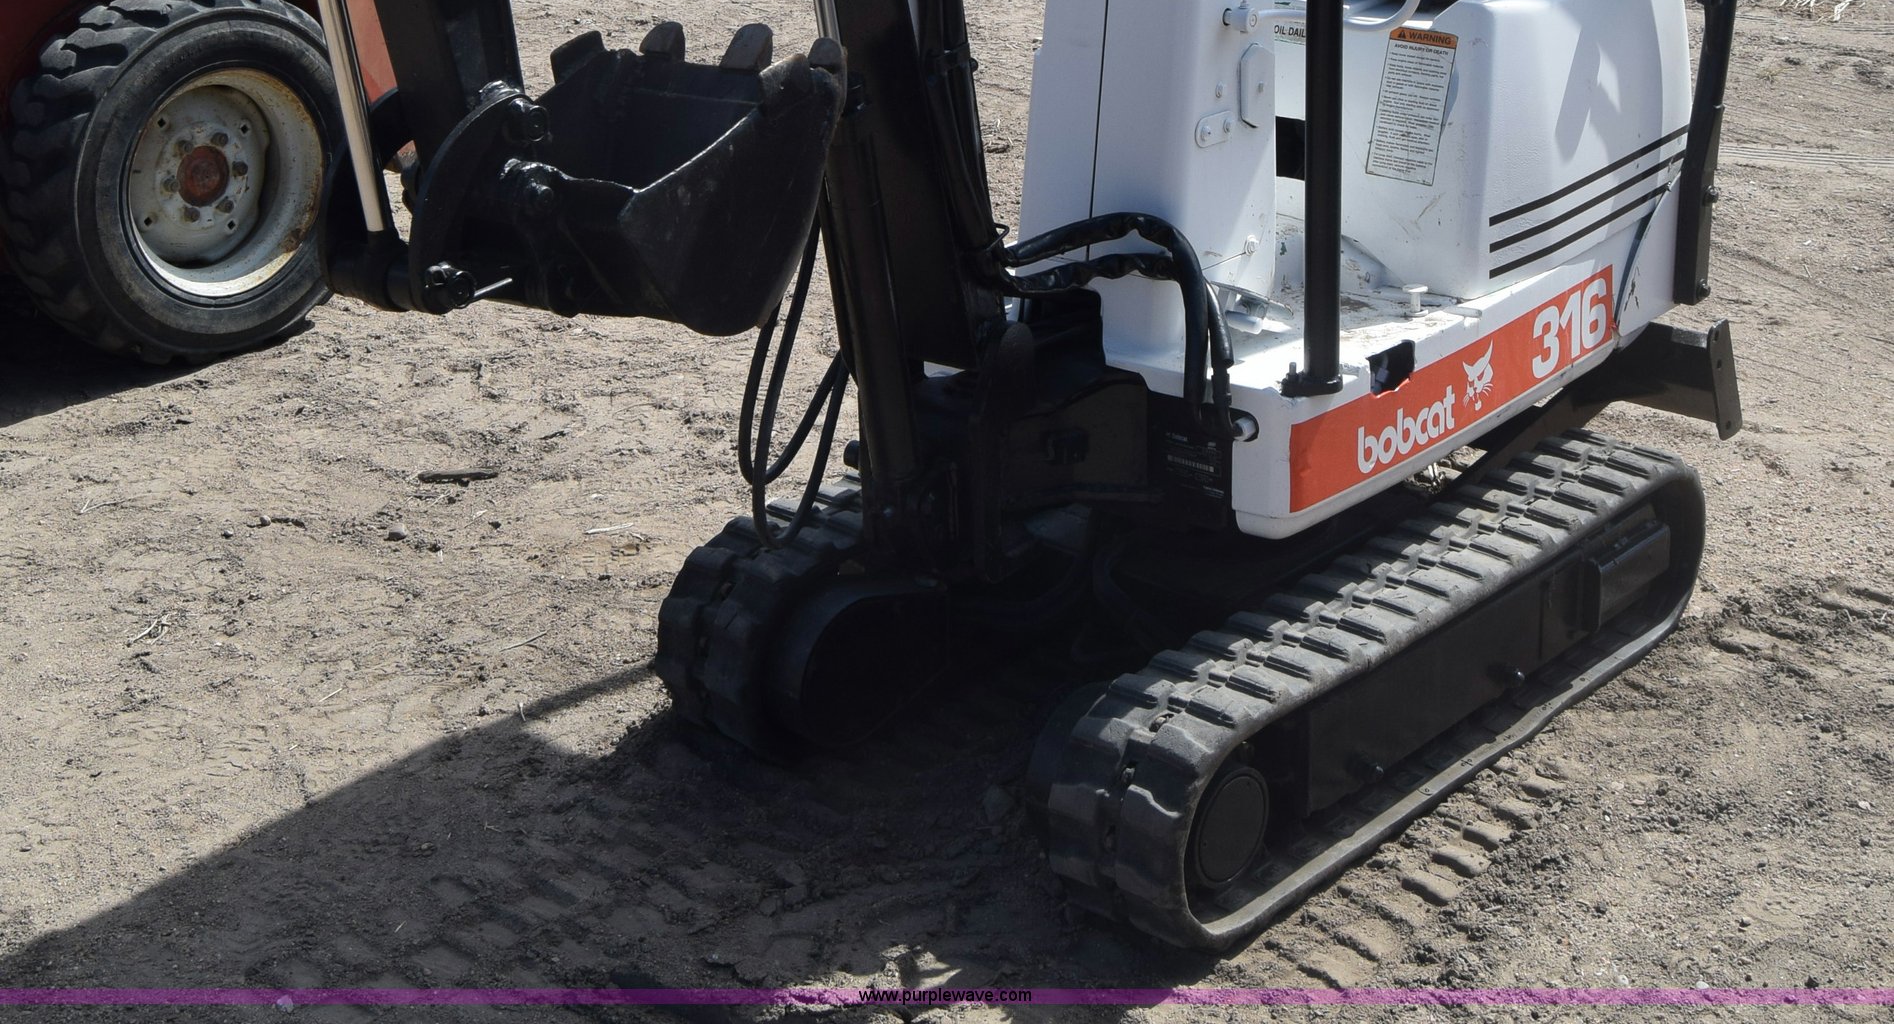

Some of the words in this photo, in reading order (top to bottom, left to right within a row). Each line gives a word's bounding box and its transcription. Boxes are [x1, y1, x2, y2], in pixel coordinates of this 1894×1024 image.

[1274, 25, 1286, 35] OIL
[1288, 27, 1306, 38] DAIL
[1409, 32, 1452, 45] WARNING
[1532, 277, 1607, 379] 316
[1356, 384, 1456, 474] bobcat
